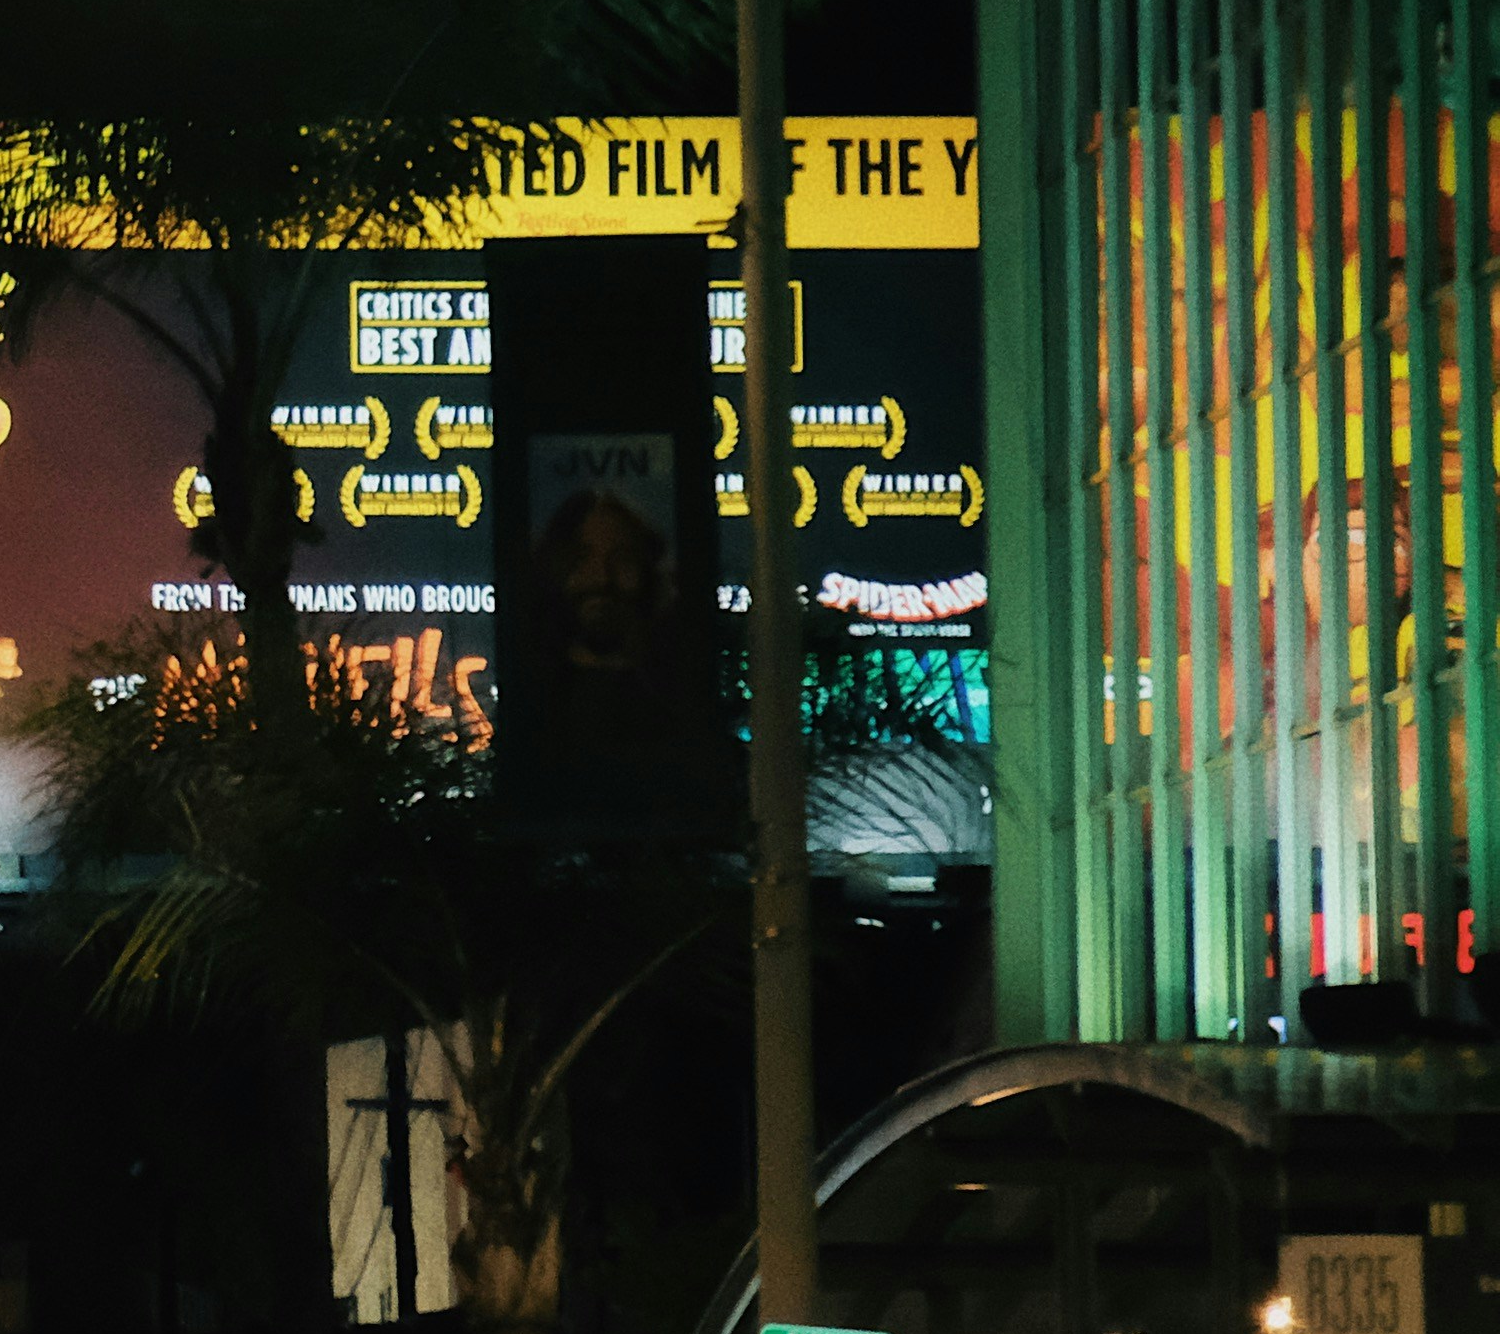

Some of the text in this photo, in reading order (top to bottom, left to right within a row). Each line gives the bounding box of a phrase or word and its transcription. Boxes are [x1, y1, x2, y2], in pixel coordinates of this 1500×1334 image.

[609, 139, 719, 196] FILM
[828, 139, 922, 196] THE
[359, 292, 451, 320] CRITICS
[358, 327, 437, 366] BEST
[288, 584, 357, 613] MANS
[362, 584, 416, 613] WHO
